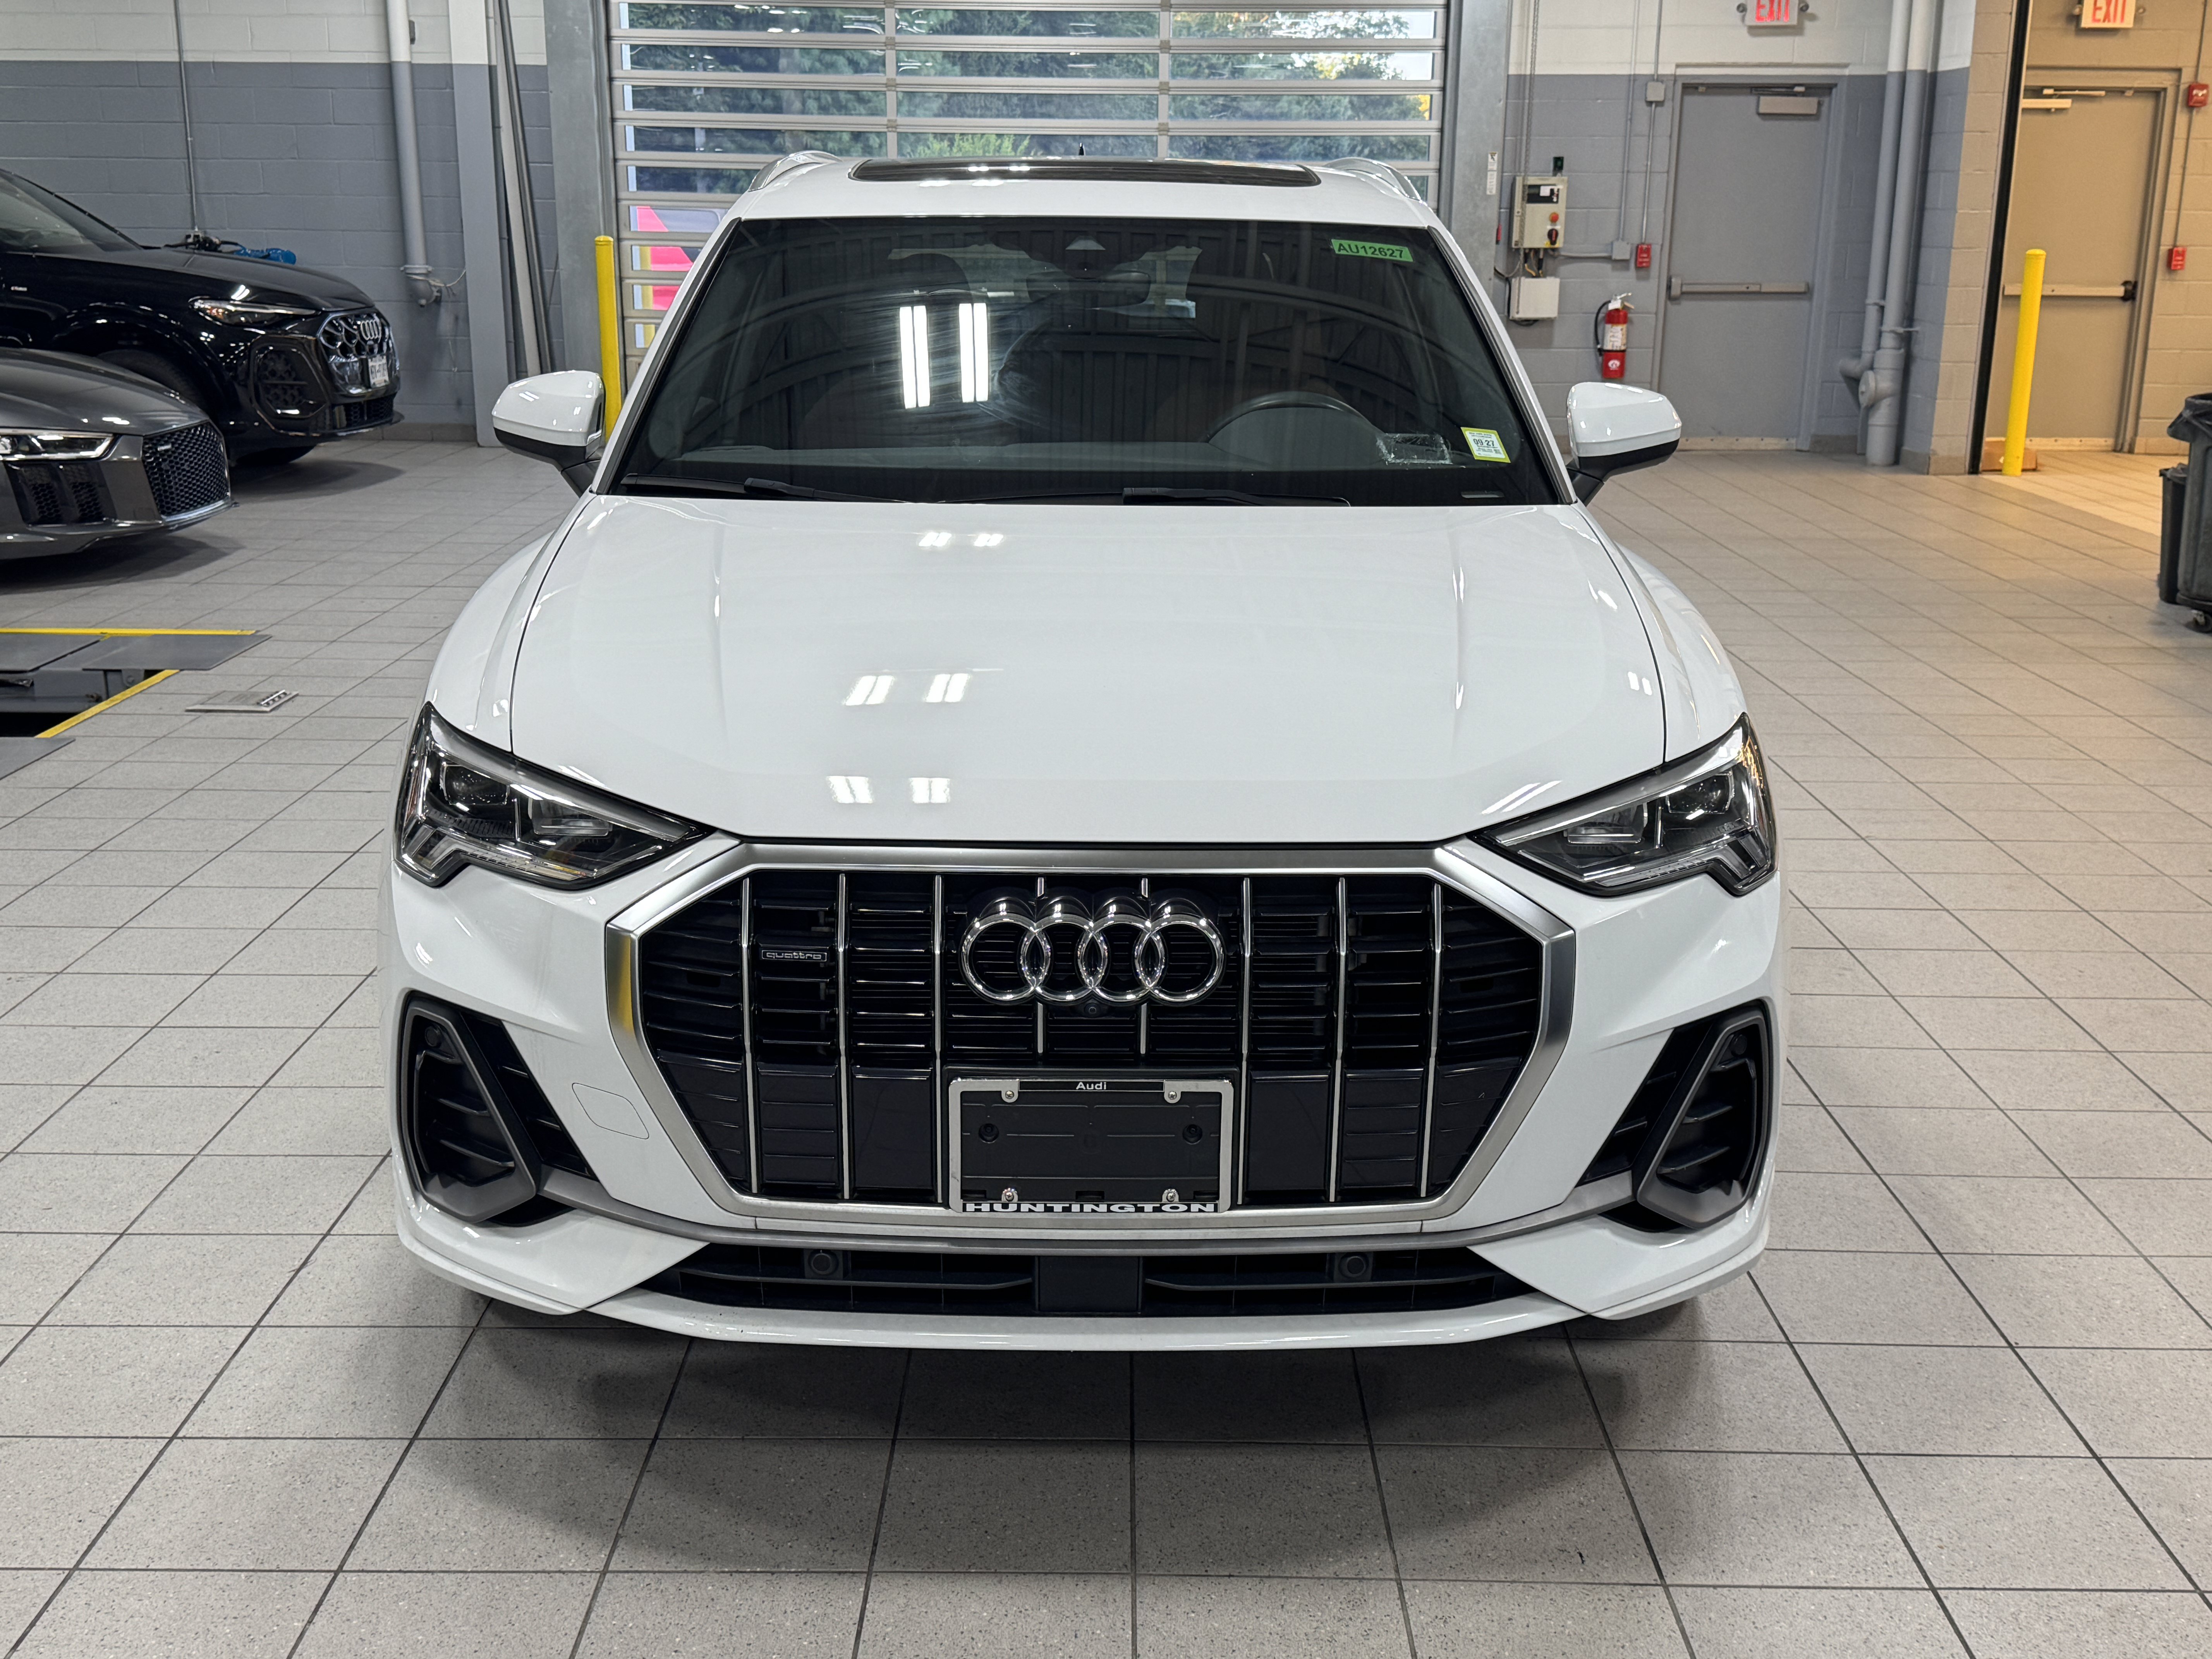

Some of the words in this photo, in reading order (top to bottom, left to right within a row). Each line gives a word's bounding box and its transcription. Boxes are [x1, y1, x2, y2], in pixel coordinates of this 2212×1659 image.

[1338, 243, 1403, 258] AU12627
[1076, 1082, 1106, 1090] Audi
[966, 1203, 1215, 1212] HUNTINGTON
